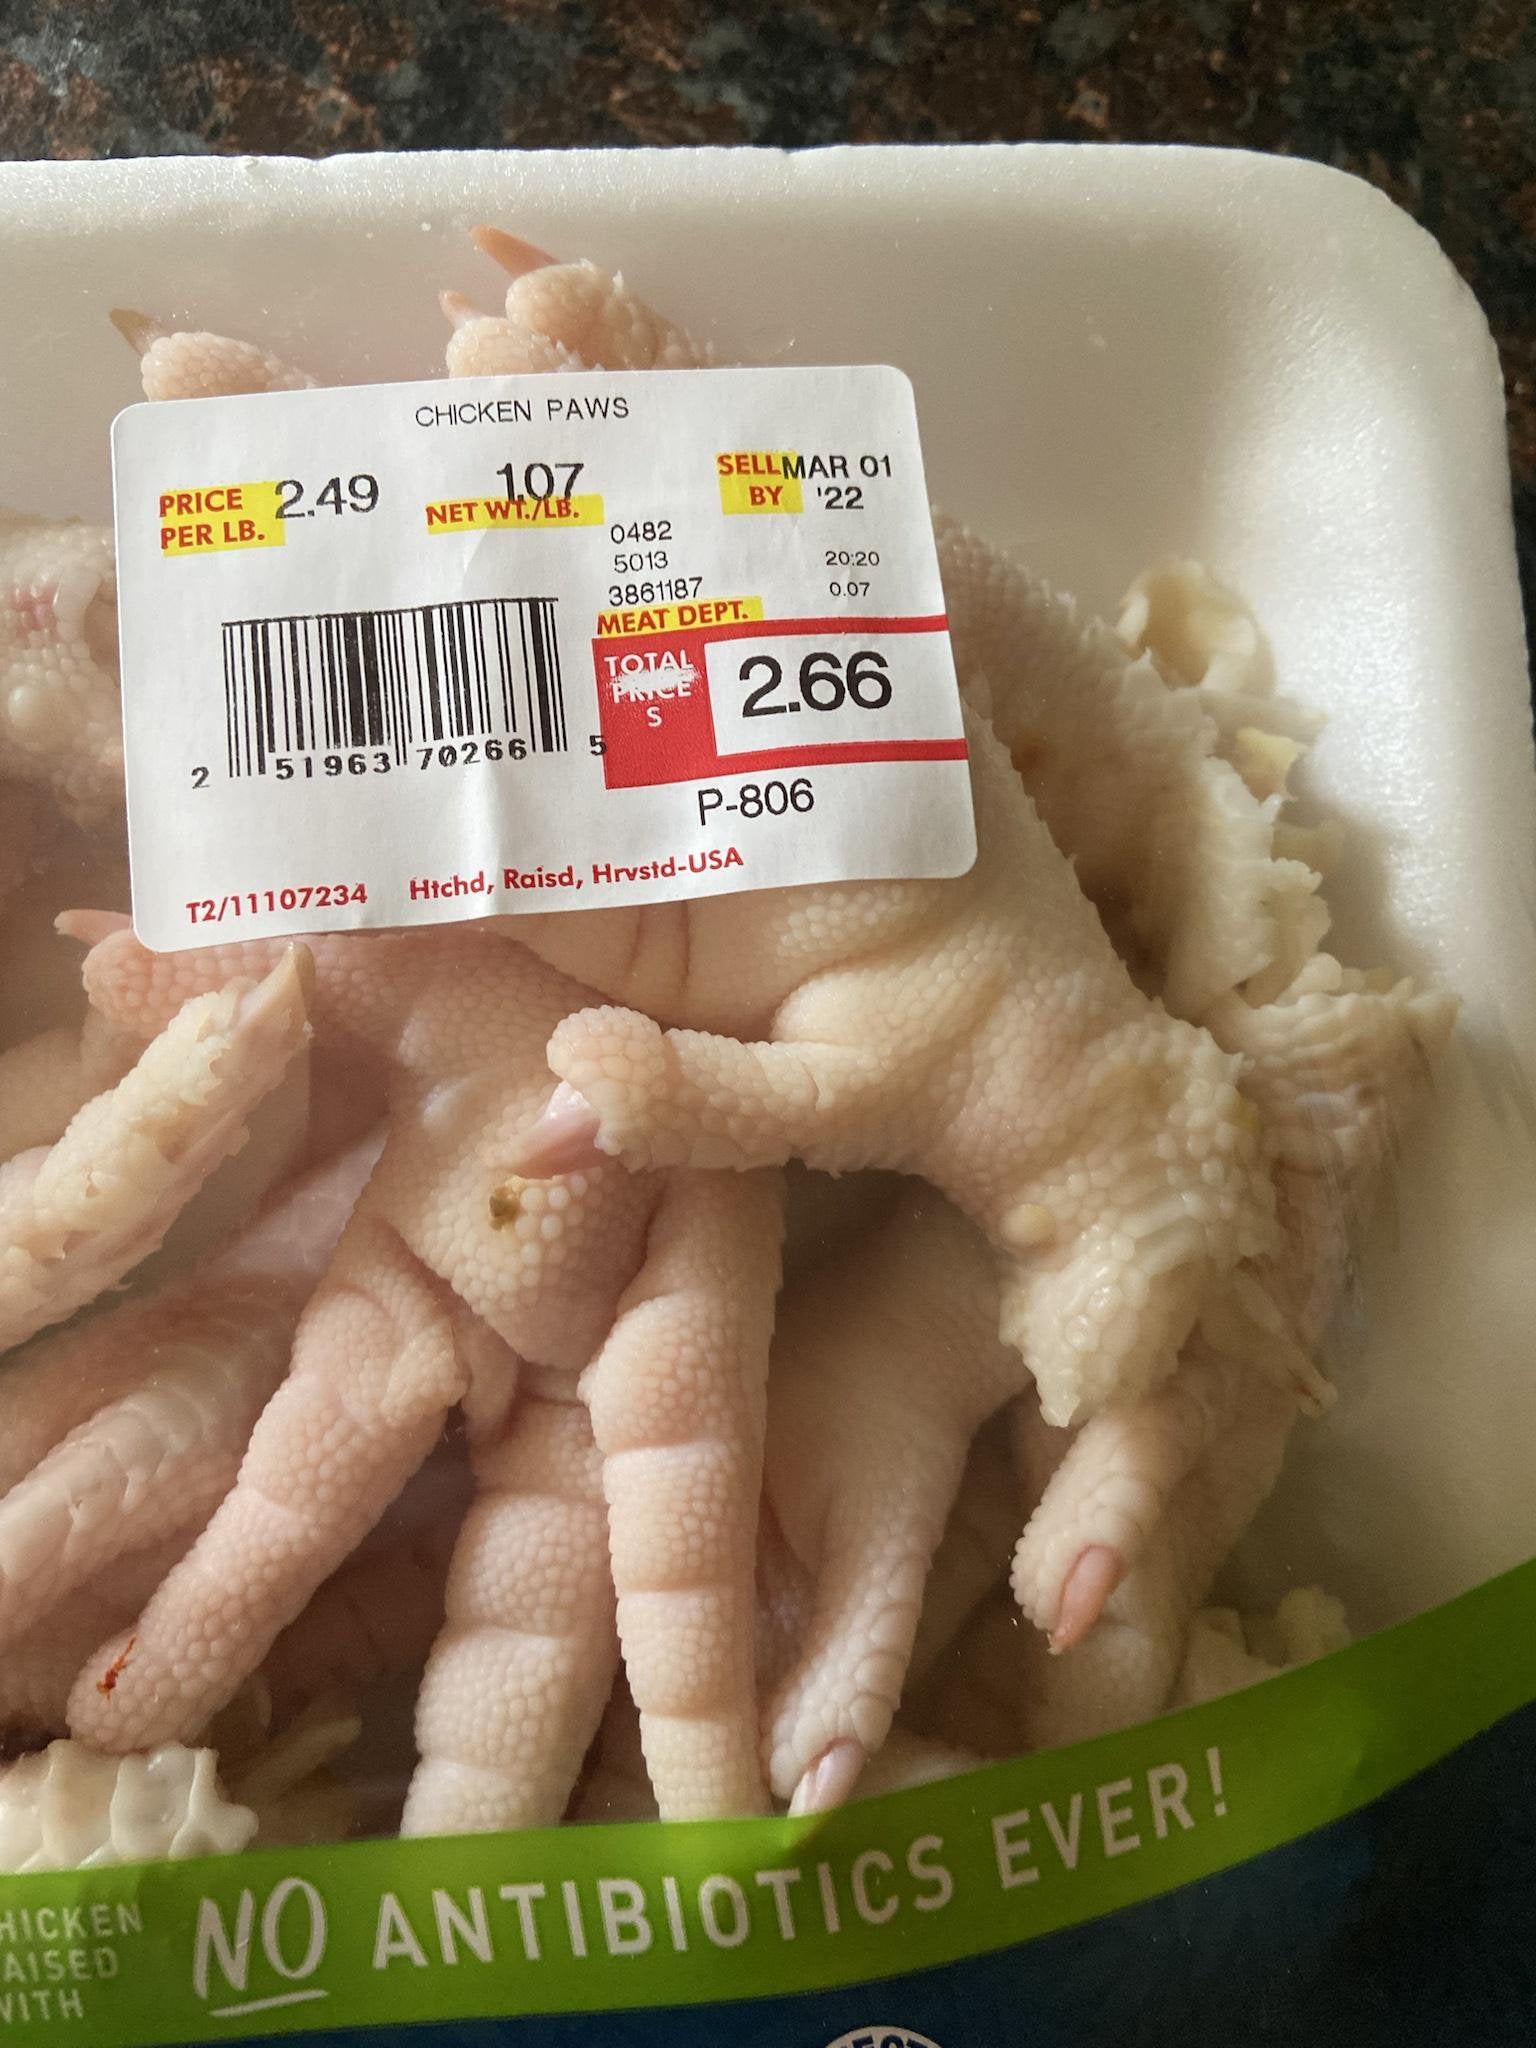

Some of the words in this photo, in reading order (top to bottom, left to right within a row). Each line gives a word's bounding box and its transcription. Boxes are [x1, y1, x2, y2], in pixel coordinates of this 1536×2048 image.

[415, 400, 531, 428] CHICKEN
[547, 397, 629, 421] PAWS
[717, 454, 781, 476] SELL
[782, 454, 849, 481] MAR
[859, 454, 892, 478] 01
[159, 488, 244, 518] PRICE
[274, 474, 380, 519] 2.49
[749, 485, 784, 506] BY
[817, 486, 864, 511] '22
[425, 502, 479, 526] NET
[160, 523, 213, 550] PER
[223, 520, 266, 543] LB.
[610, 521, 673, 544] 0482
[613, 551, 669, 573] 5013
[825, 550, 880, 567] 20:20
[608, 577, 703, 607] 3861187
[829, 582, 870, 597] 0.07
[597, 608, 670, 635] MEAT
[678, 600, 749, 626] DEPT.
[604, 649, 694, 677] TOTAL
[738, 650, 893, 719] 2.66
[191, 766, 210, 790] 2
[275, 751, 391, 781] 51963
[418, 737, 528, 771] 70266
[589, 734, 608, 756] 5
[698, 778, 815, 826] P-806
[186, 882, 368, 924] T2/11107234
[409, 871, 494, 901] Htchd,
[503, 865, 583, 890] Raisd,
[592, 847, 744, 884] Hrvstd-USA
[193, 1876, 328, 1999] NO
[372, 1834, 953, 1970] ANTIBIOTICS
[991, 1747, 1228, 1890] EVER!
